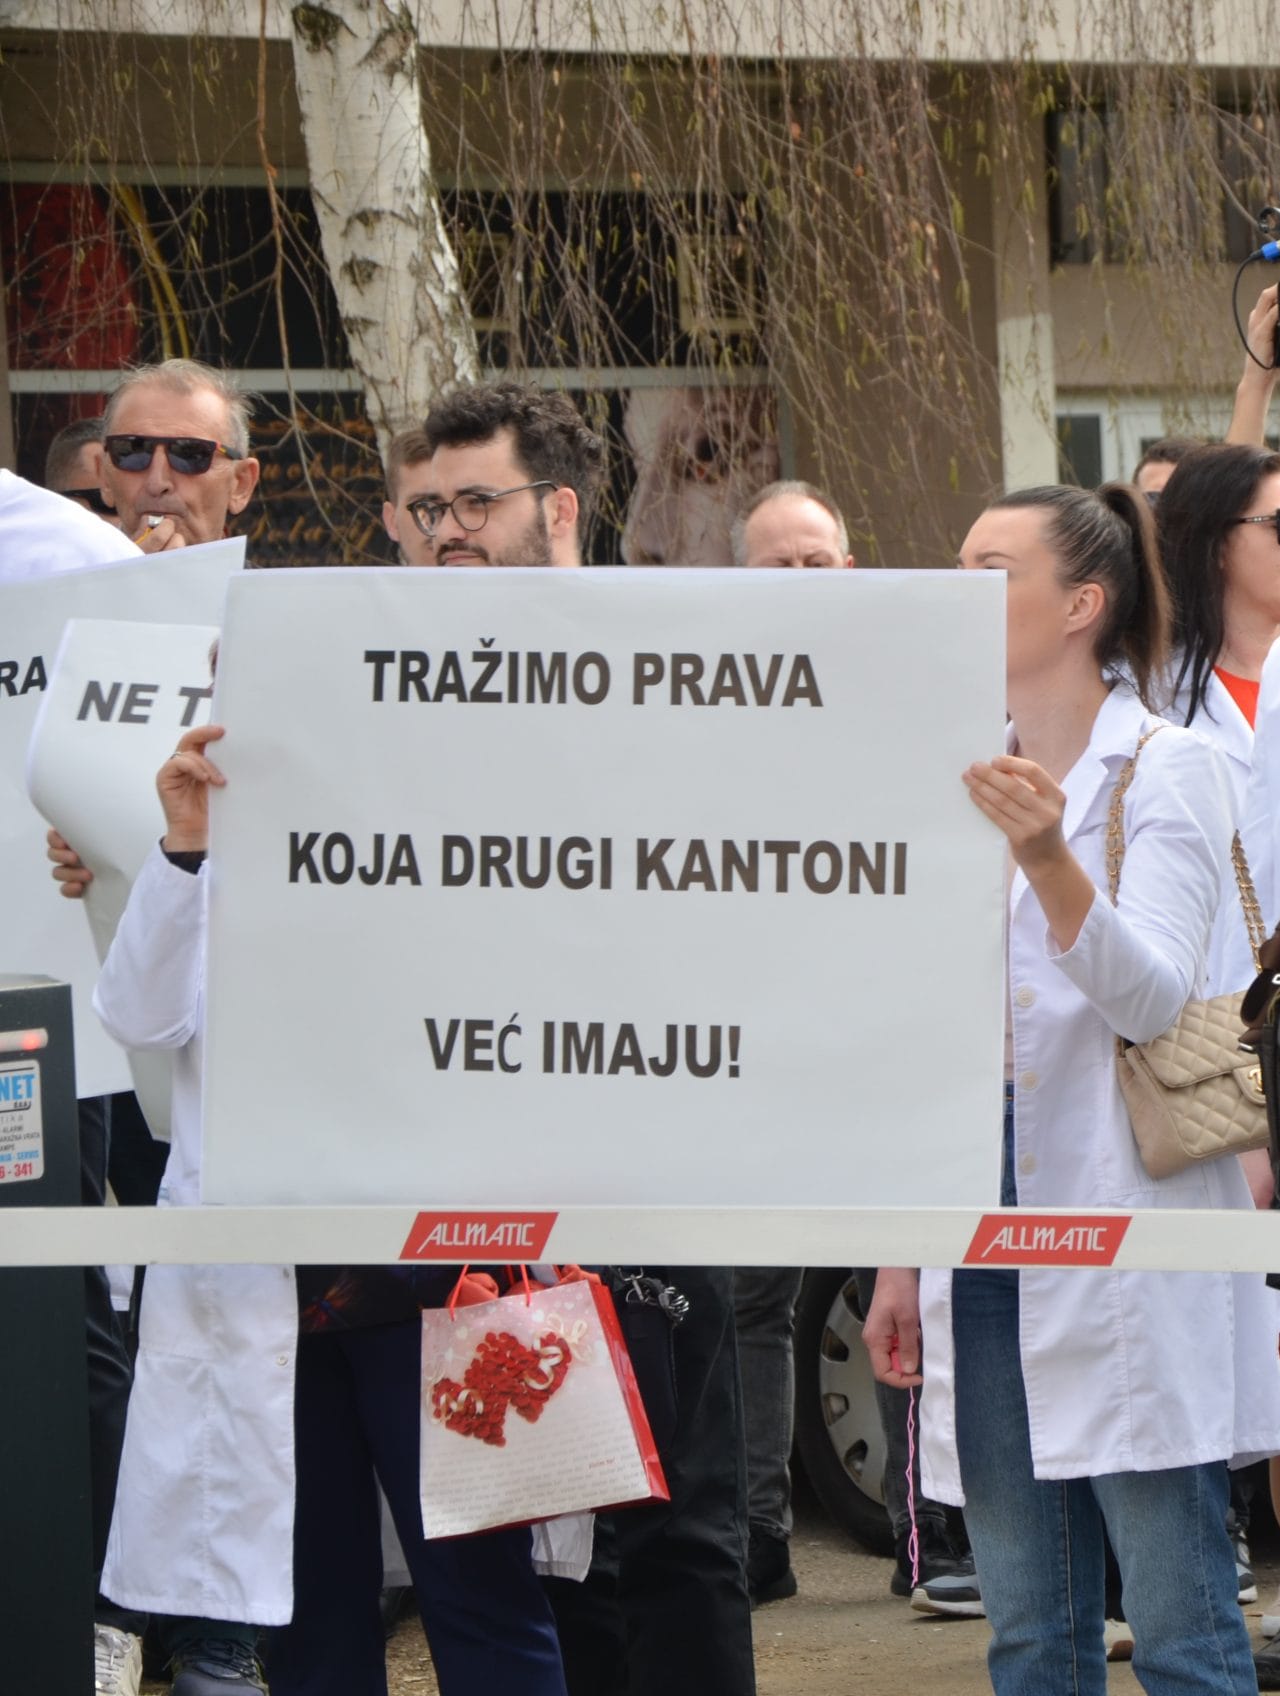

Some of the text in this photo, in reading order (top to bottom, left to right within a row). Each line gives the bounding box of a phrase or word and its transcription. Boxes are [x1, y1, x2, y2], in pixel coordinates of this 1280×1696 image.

[364, 637, 823, 707] TRAŽIMO PRAVA
[77, 680, 159, 724] NE
[289, 831, 907, 896] KOJA DRUGI KANTONI
[424, 1012, 741, 1079] VEĆ IMAJU!
[14, 1163, 33, 1177] 341
[416, 1222, 536, 1255] ALLMATIC
[981, 1225, 1108, 1258] ALLMATIC
